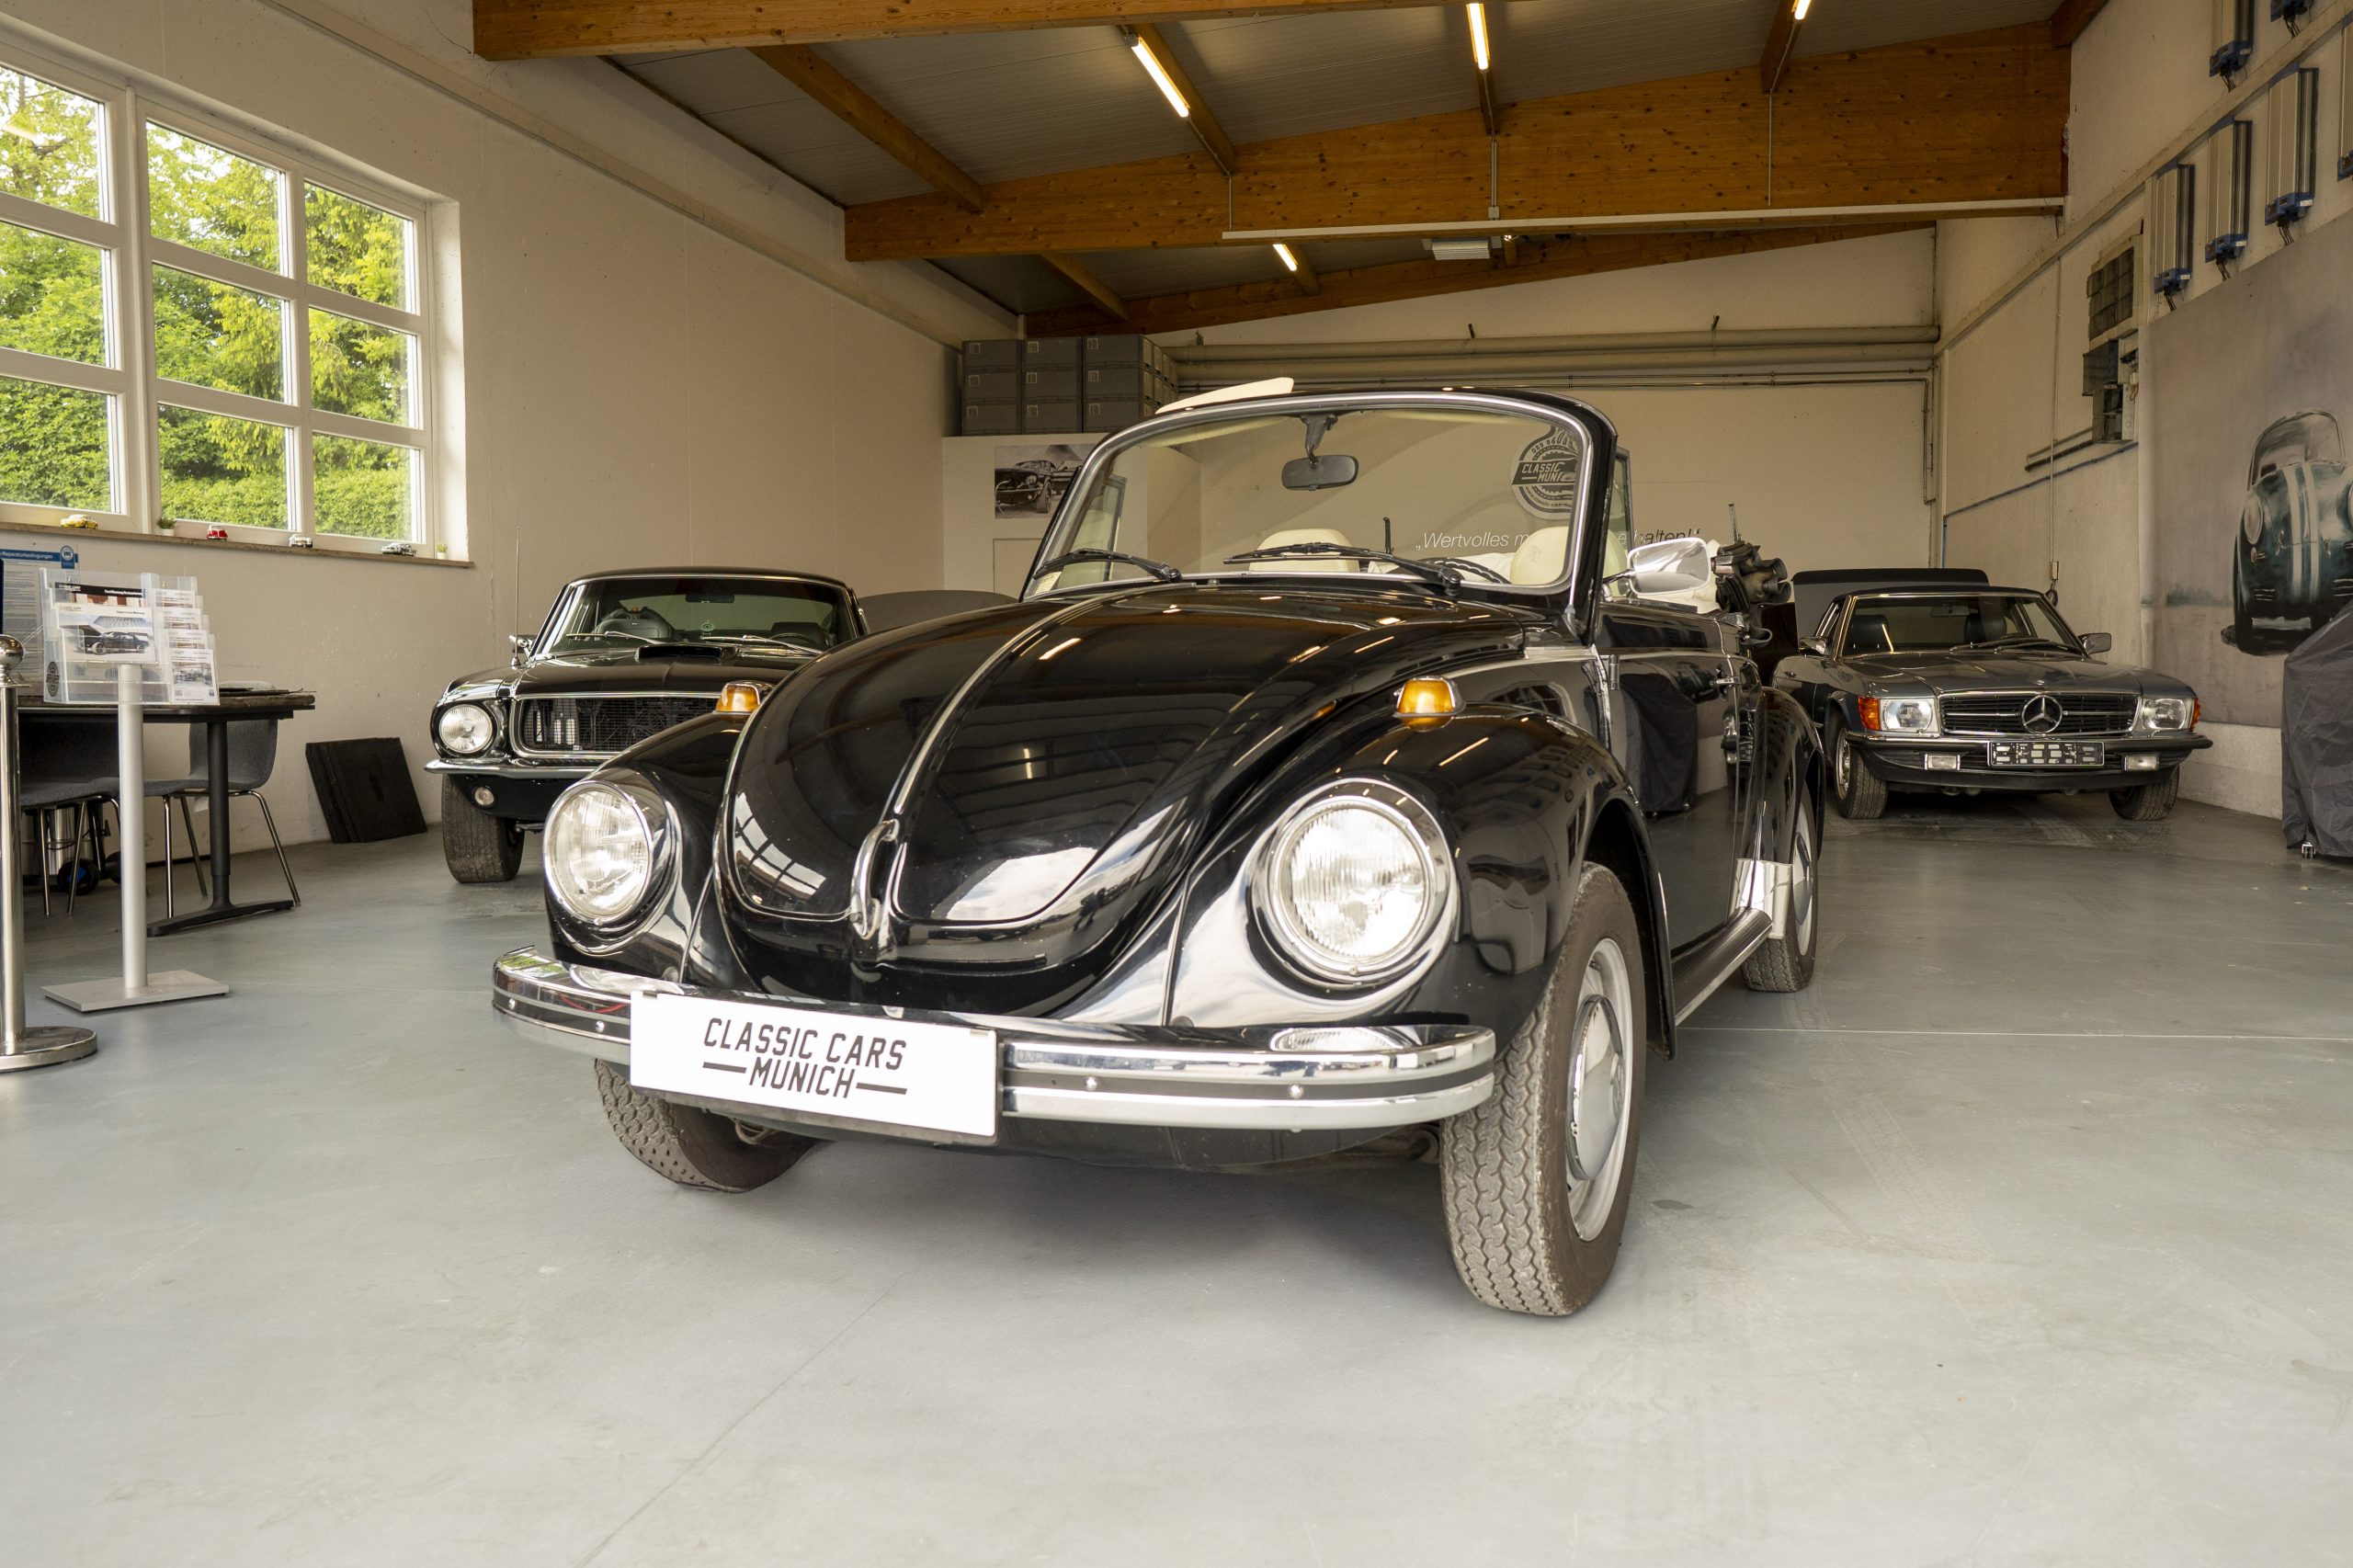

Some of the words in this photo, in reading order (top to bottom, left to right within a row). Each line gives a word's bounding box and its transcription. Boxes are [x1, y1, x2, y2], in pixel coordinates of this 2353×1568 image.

[1521, 461, 1565, 474] CLASSIC
[703, 1017, 818, 1060] CLASSIC
[825, 1033, 907, 1071] CARS
[749, 1057, 856, 1098] MUNICH
